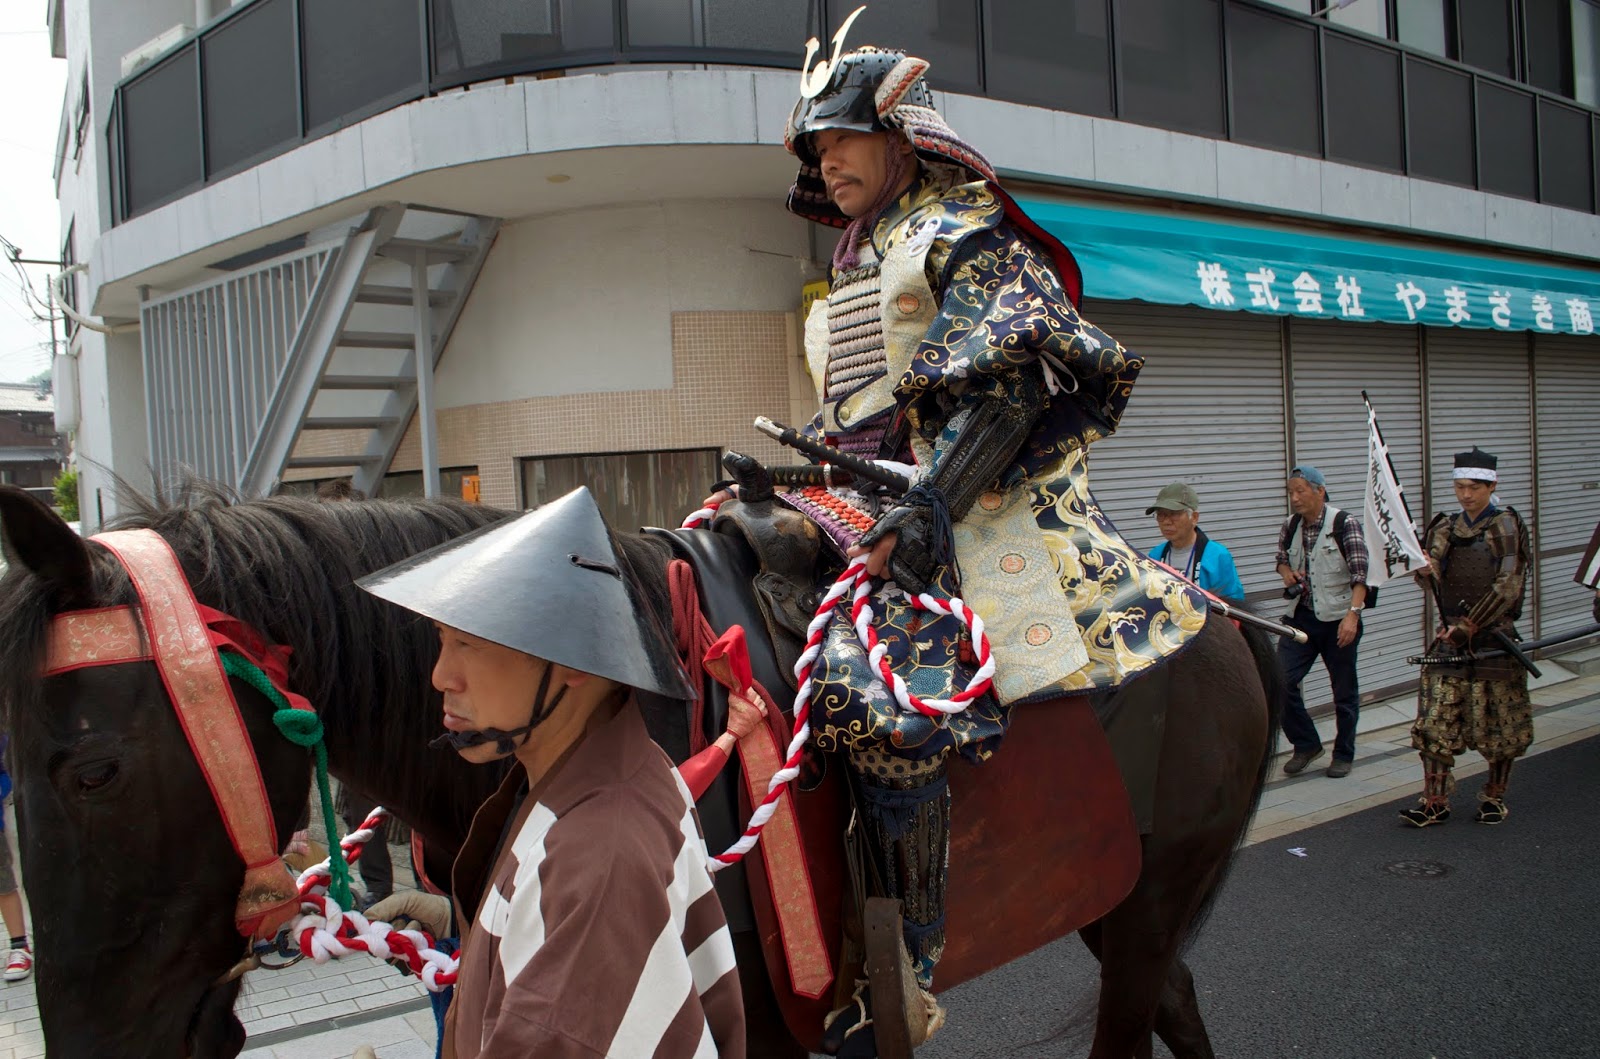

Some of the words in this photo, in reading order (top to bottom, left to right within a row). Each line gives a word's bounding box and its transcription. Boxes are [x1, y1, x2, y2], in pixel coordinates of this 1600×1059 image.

[1196, 261, 1365, 316] 株式会社
[1395, 281, 1594, 333] やまざき商
